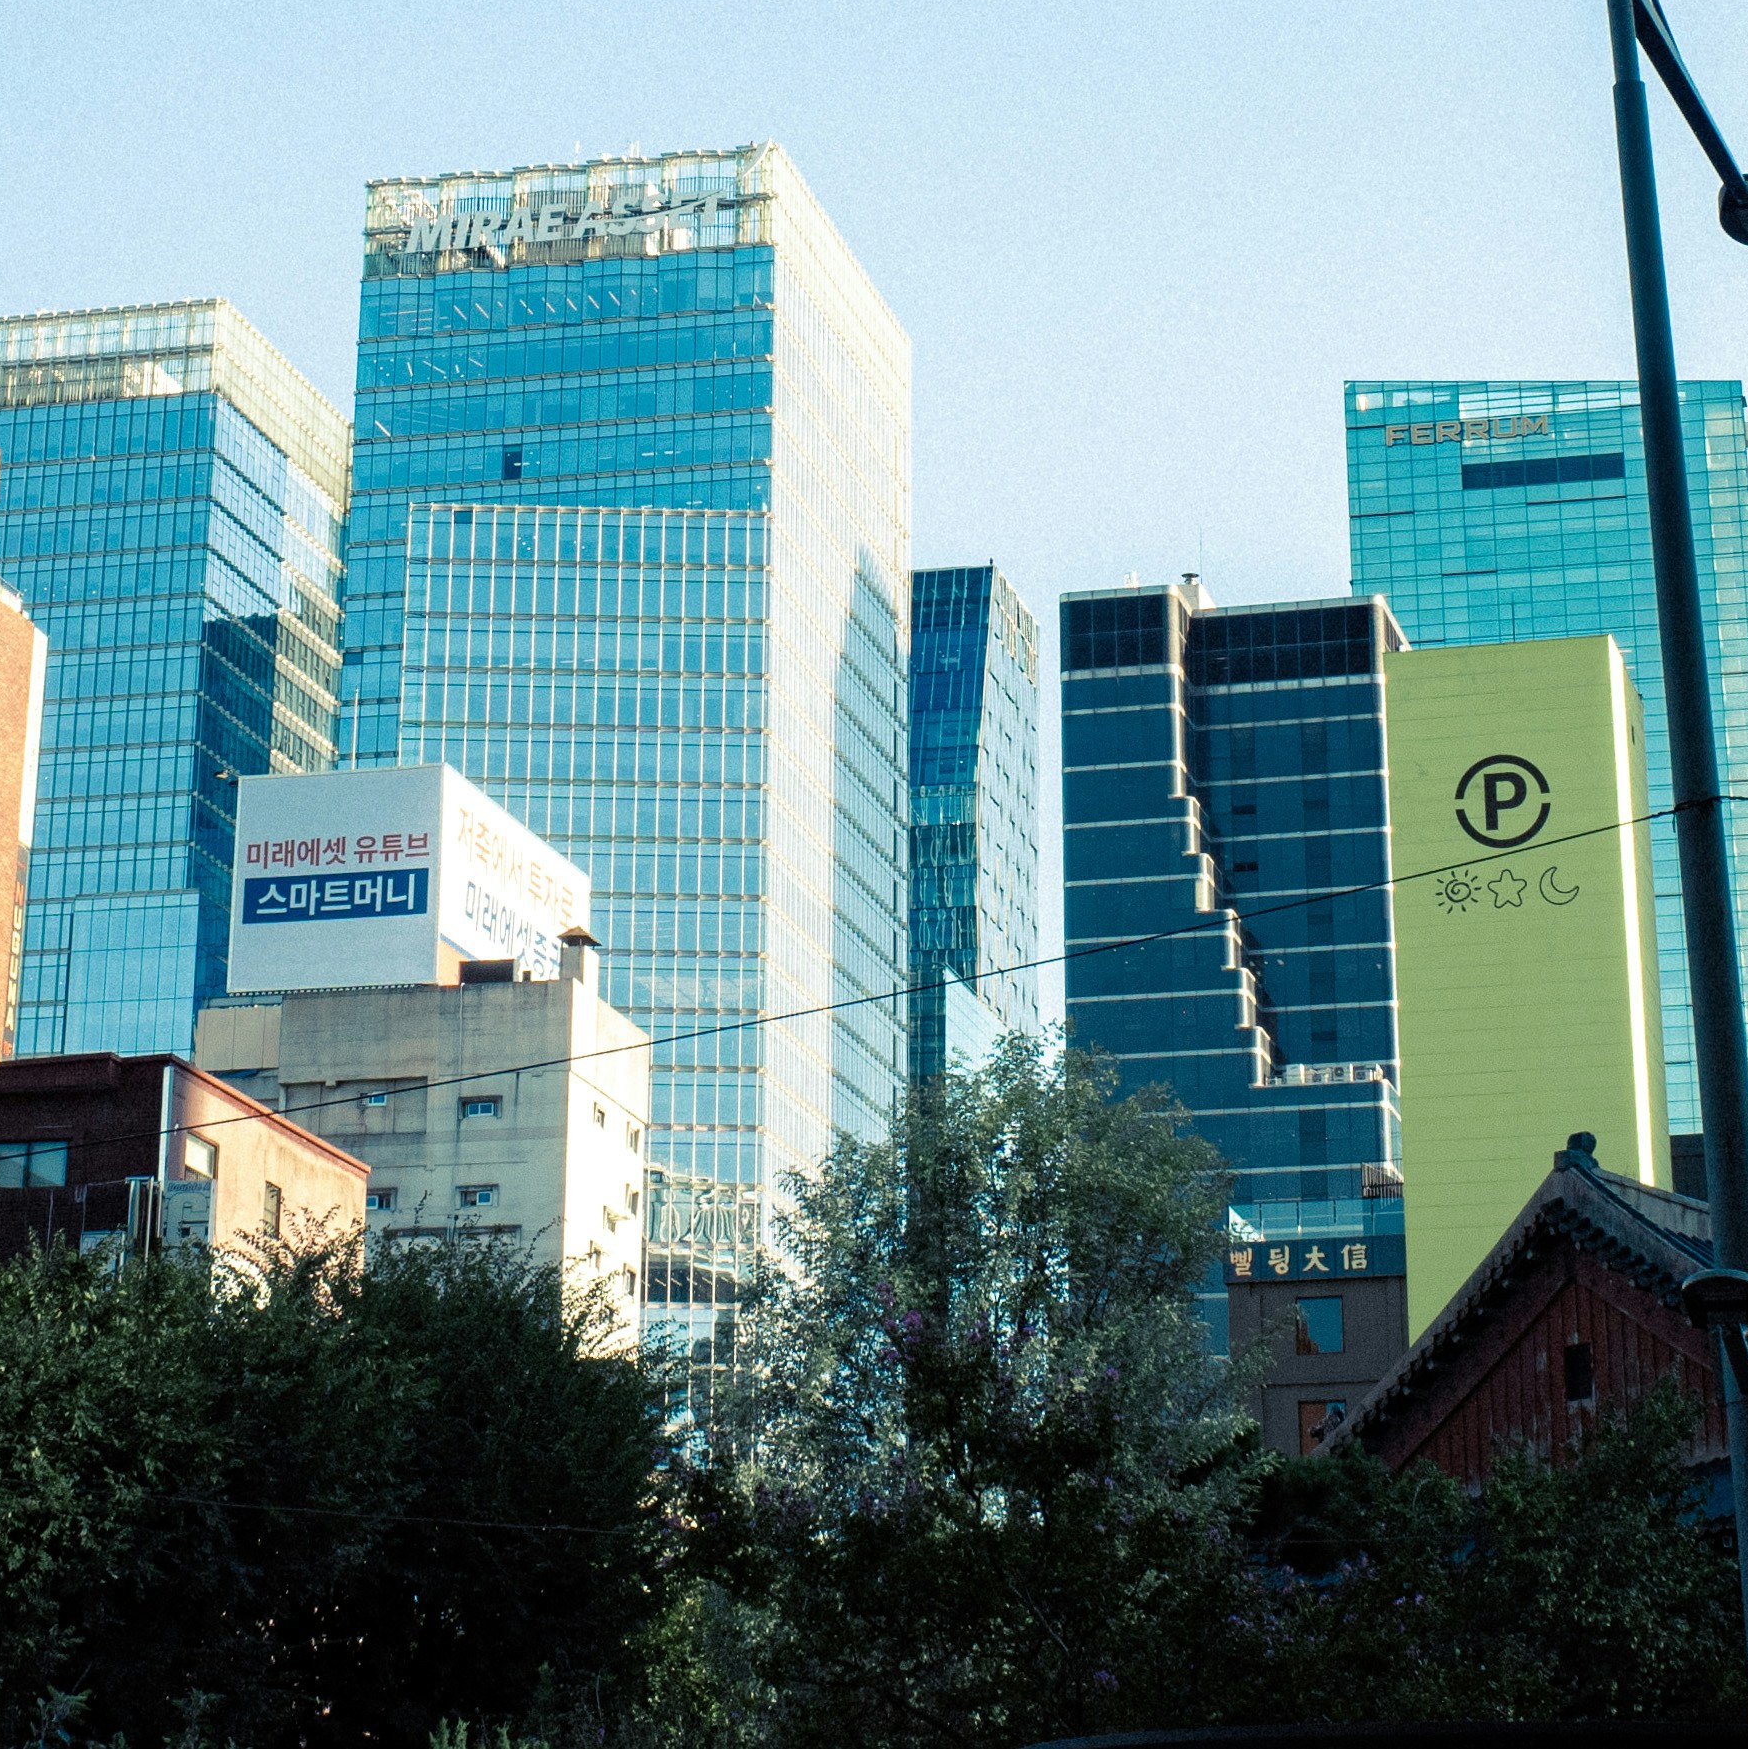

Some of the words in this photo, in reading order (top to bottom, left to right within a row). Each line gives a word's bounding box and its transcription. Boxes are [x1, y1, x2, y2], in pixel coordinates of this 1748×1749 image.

[405, 203, 567, 254] MIRAE
[572, 189, 728, 238] ASSET
[1386, 414, 1548, 447] FERRUM
[1483, 771, 1528, 831] P
[246, 836, 347, 869] 미래에셋
[354, 832, 430, 864] 유튜브
[458, 807, 525, 901] 저축에서
[528, 860, 574, 931] 투자로
[256, 873, 416, 917] 스마트머니
